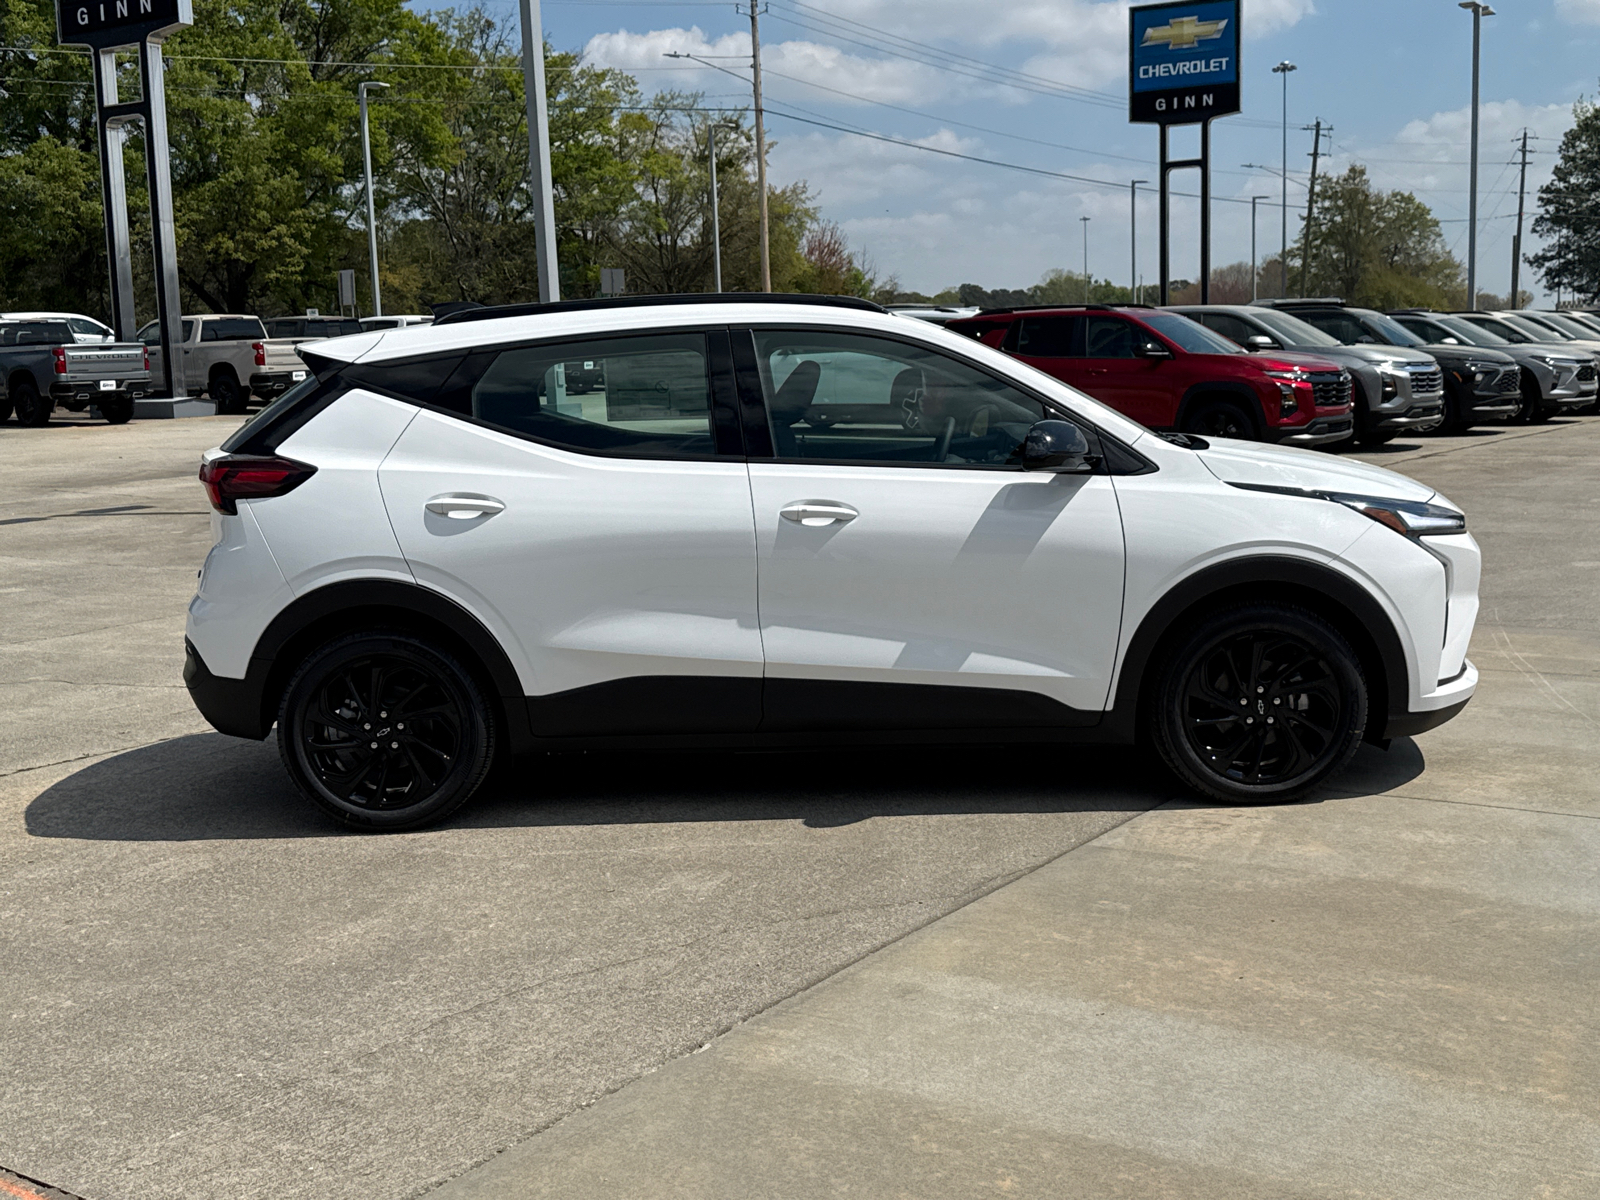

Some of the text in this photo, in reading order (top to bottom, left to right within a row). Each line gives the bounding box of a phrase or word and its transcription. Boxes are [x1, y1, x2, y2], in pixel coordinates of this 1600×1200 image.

[77, 0, 152, 25] GINN
[1139, 57, 1229, 78] CHEVROLET
[1155, 93, 1213, 111] GINN
